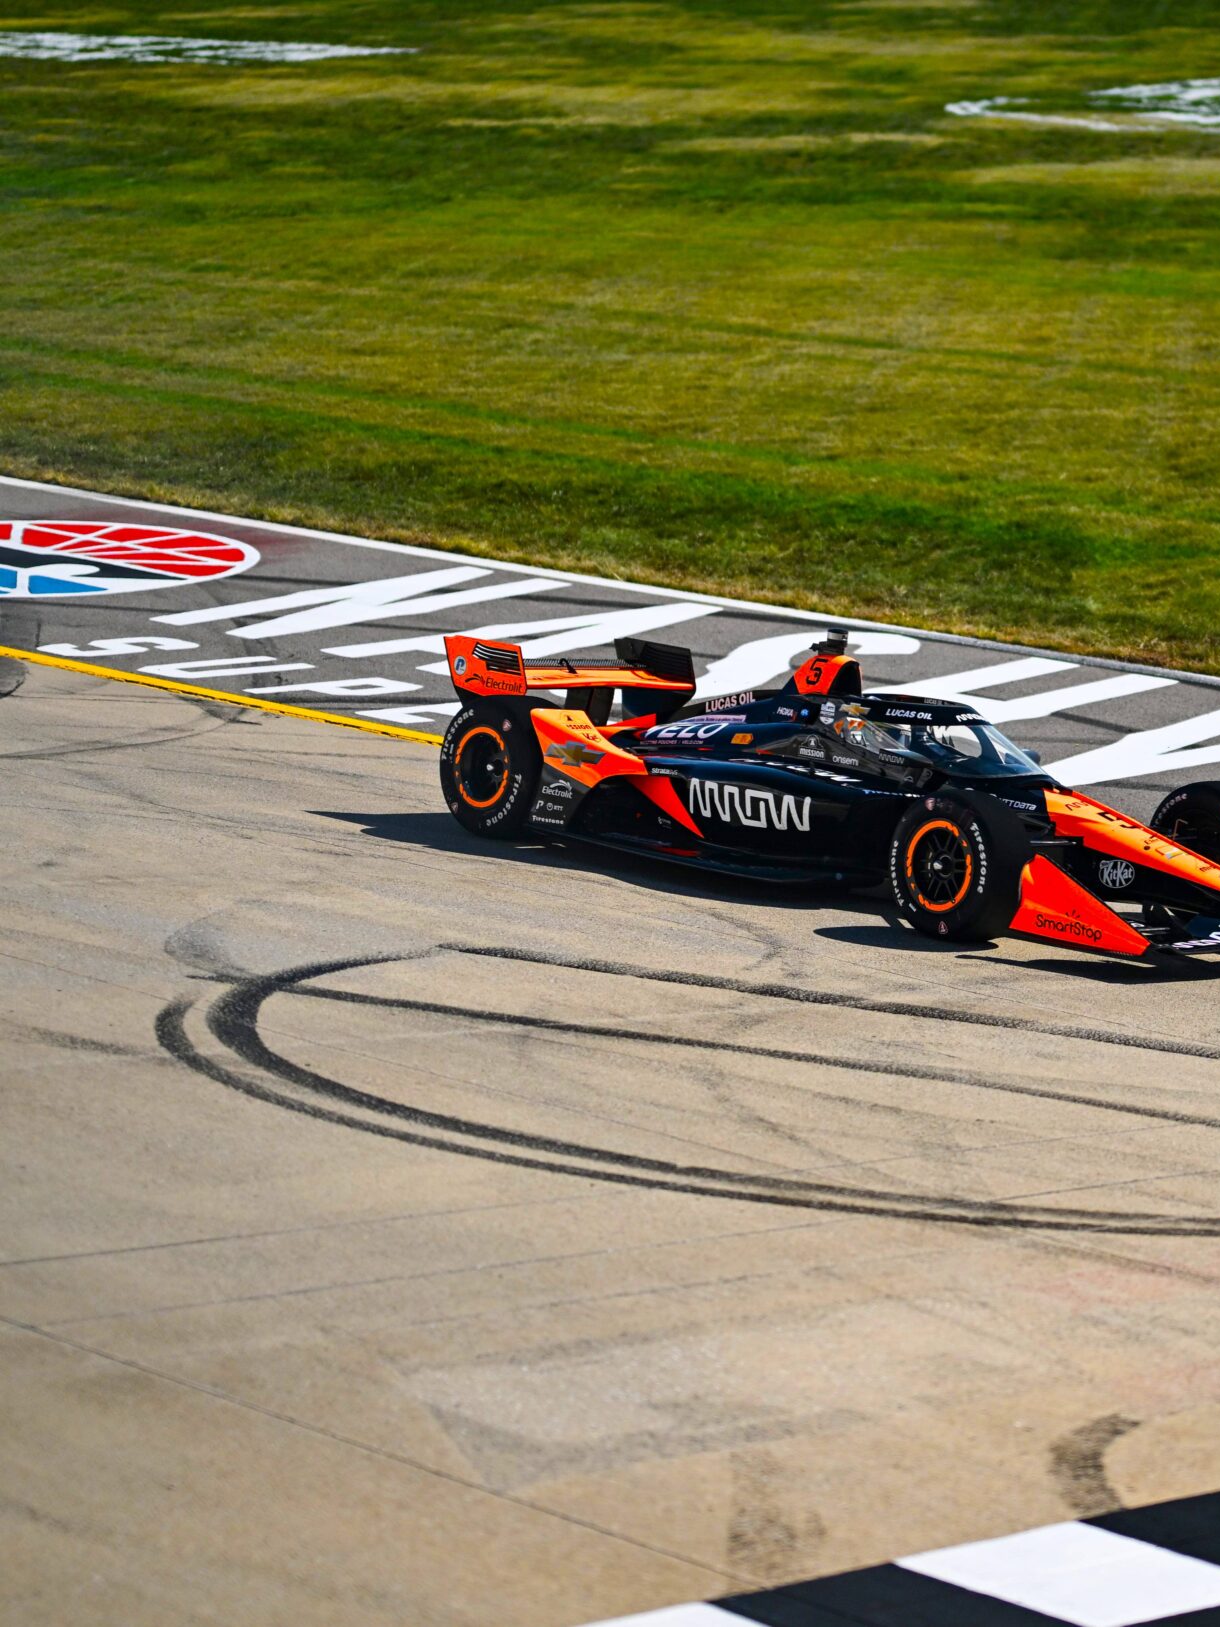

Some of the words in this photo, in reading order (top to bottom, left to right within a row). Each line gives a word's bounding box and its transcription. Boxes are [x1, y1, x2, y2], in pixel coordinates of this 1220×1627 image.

[805, 658, 828, 685] 5
[485, 677, 522, 694] Electrolit
[705, 694, 738, 713] LUCAS
[739, 691, 756, 705] OIL
[885, 708, 916, 719] LUCAS
[916, 711, 933, 720] OIL
[644, 723, 729, 739] VELO
[832, 755, 859, 767] onsemi
[541, 785, 574, 799] Electrolit
[689, 777, 812, 832] ARROW
[531, 814, 565, 825] Firestone
[969, 822, 988, 894] Firestone
[890, 839, 905, 907] Firestone
[1103, 861, 1133, 888] KitKat
[1035, 913, 1103, 942] SmartStop
